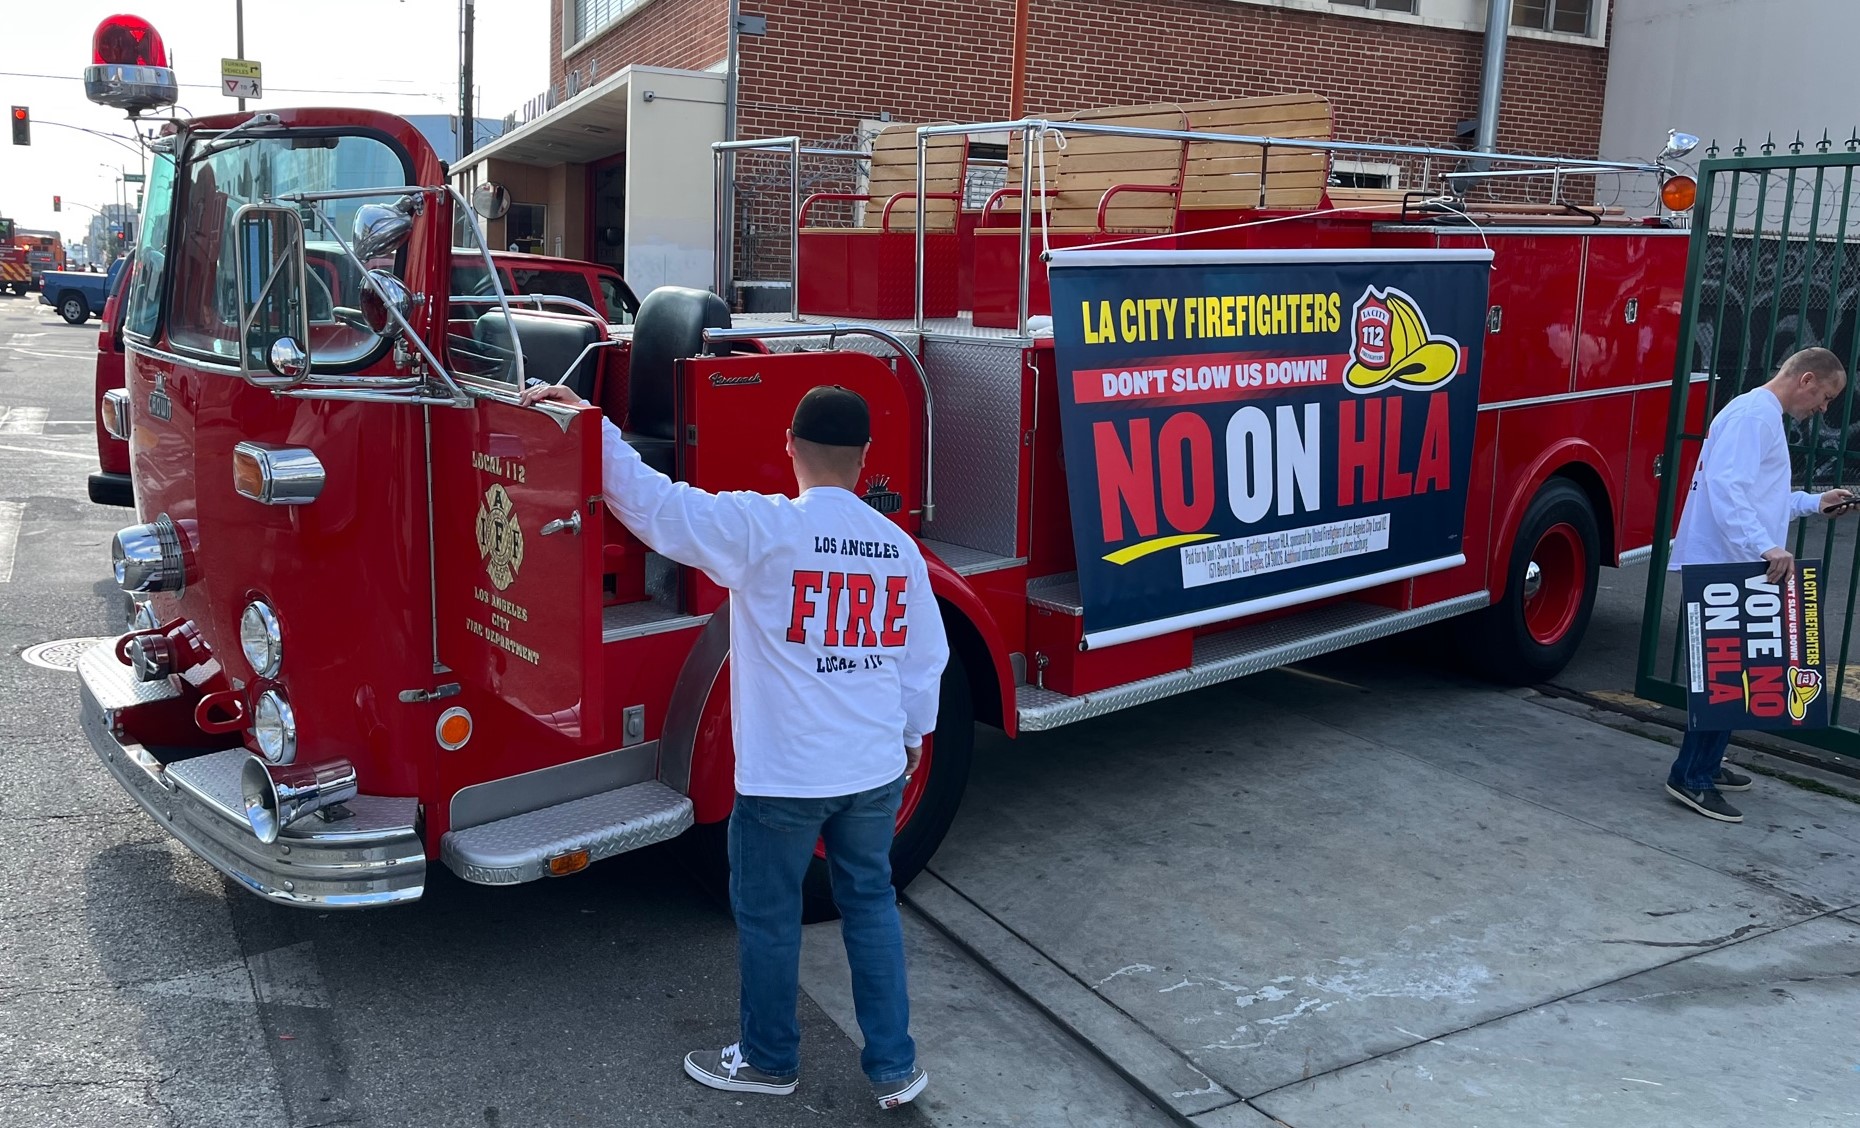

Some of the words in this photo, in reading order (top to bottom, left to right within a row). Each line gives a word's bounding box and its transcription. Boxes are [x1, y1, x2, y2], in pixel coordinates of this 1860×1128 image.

[1081, 299, 1116, 345] LA
[1120, 298, 1178, 344] CITY
[1184, 292, 1341, 340] FIREFIGHTERS
[1372, 310, 1386, 320] CITY
[1362, 326, 1384, 347] 112
[1102, 369, 1168, 398] DON'T
[1172, 365, 1231, 392] SLOW
[1234, 362, 1263, 388] US
[1265, 359, 1328, 384] DOWN!
[472, 450, 502, 476] LOCAL
[506, 460, 526, 484] 112
[1092, 410, 1216, 544] NO
[1226, 402, 1321, 524] ON
[1336, 391, 1450, 507] HLA
[493, 490, 504, 510] A
[814, 536, 837, 554] LOS
[840, 538, 900, 559] ANGELES
[1788, 574, 1796, 598] ON'T
[1803, 568, 1816, 580] LA
[474, 586, 489, 604] LOS
[492, 594, 528, 622] ANGELES
[1703, 582, 1740, 630] ON
[1804, 581, 1817, 602] CITY
[492, 612, 510, 632] CITY
[786, 570, 908, 648] FIRE
[1744, 574, 1782, 658] VOTE
[1788, 598, 1796, 622] SLOW
[466, 617, 483, 636] FIRE
[485, 627, 540, 665] DEPARTMENT
[1789, 622, 1797, 634] US
[1804, 602, 1820, 666] FIREFIGHTERS
[816, 656, 856, 673] LOCAL
[1706, 638, 1744, 704] HLA
[1748, 666, 1786, 718] NO
[463, 865, 520, 884] CROWN
